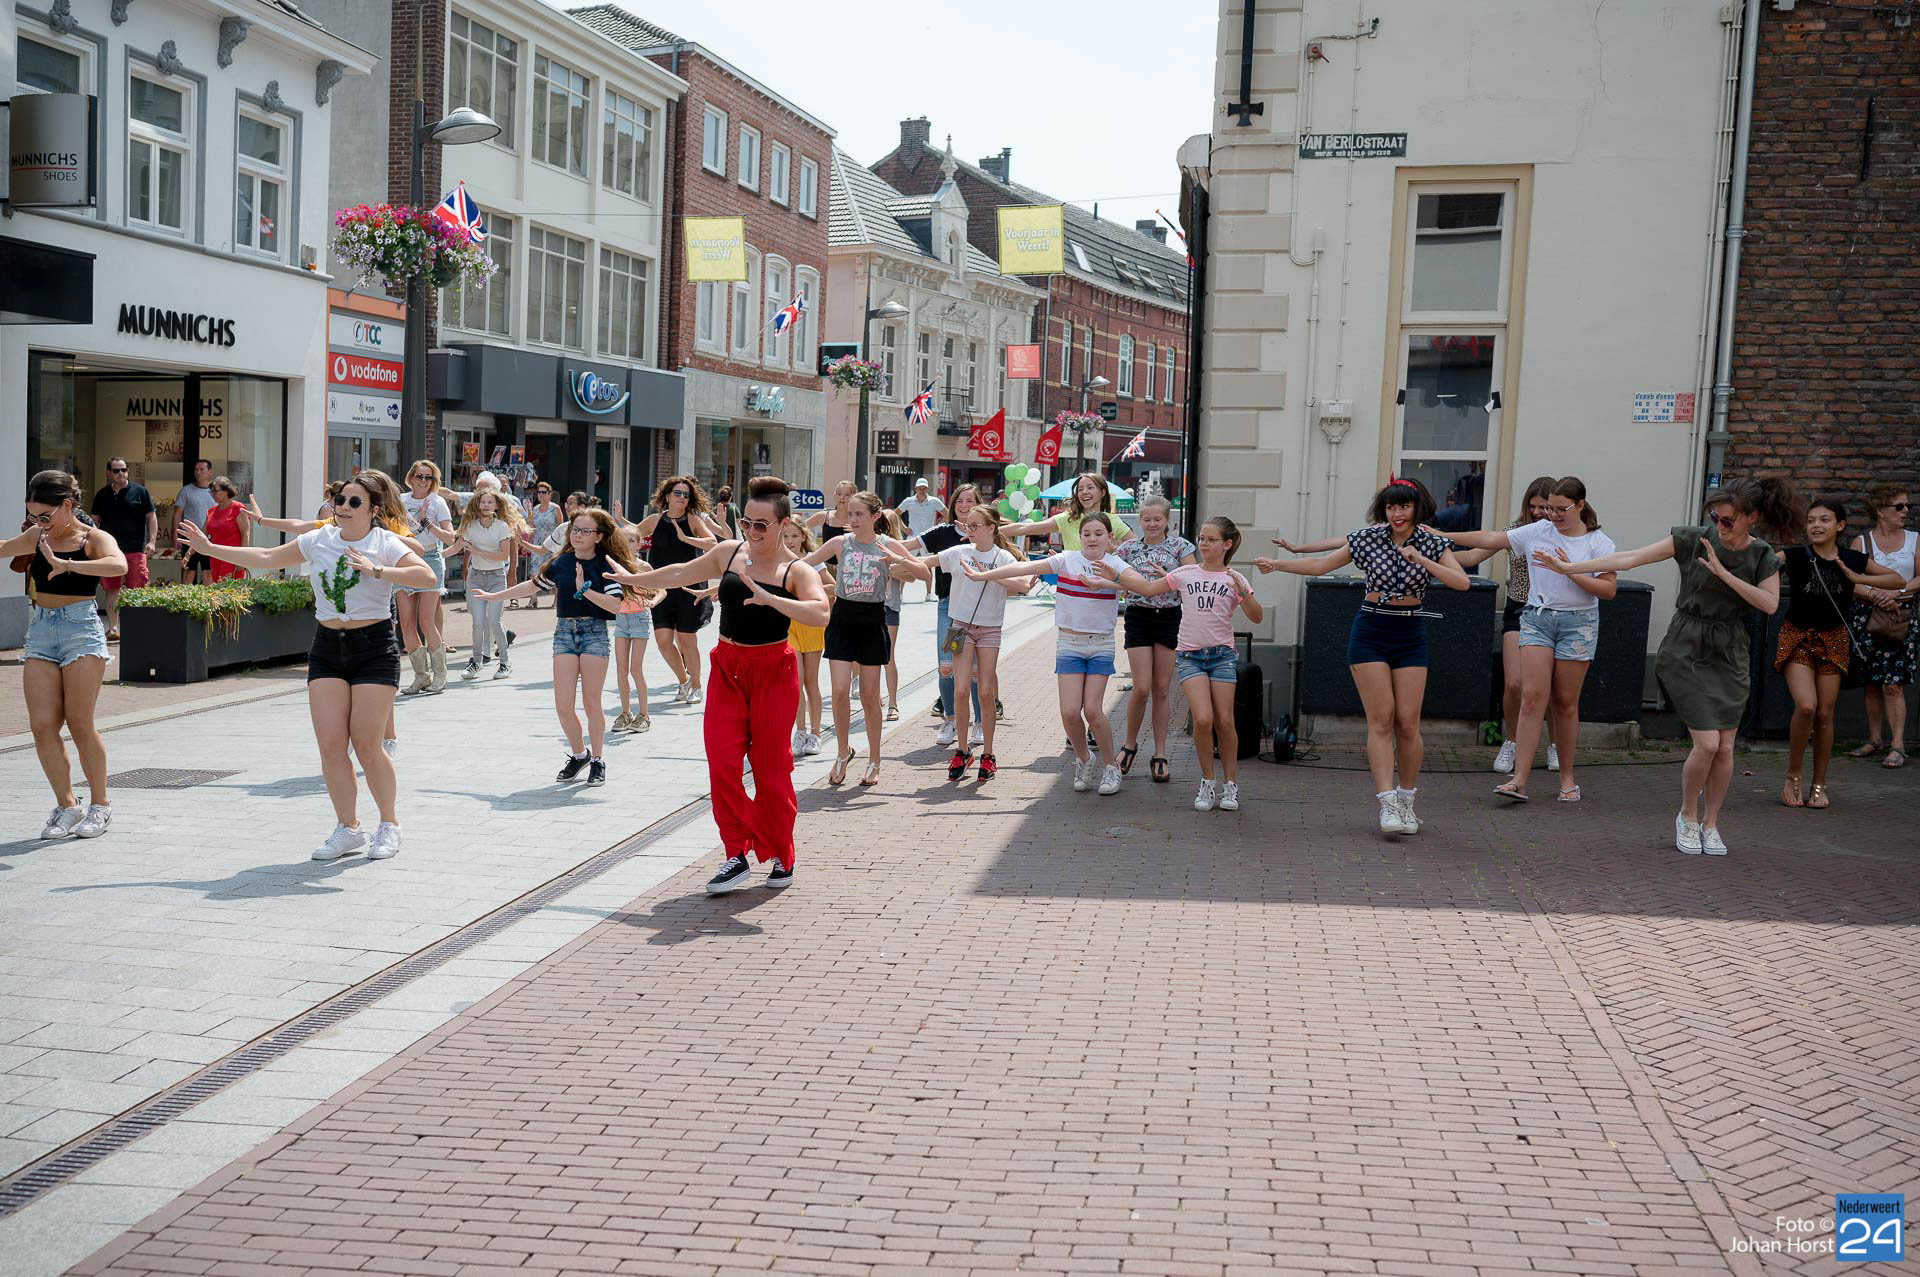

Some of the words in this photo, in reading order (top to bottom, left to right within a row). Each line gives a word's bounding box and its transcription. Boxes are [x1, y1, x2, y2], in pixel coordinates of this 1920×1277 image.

[1301, 136, 1322, 150] VAN
[1325, 136, 1405, 149] BERLOSTRAAT
[11, 152, 78, 166] MUNNICHS
[43, 171, 78, 182] SHOES
[118, 302, 236, 347] MUNNICHS
[364, 323, 381, 345] TCC
[351, 362, 398, 383] vodafone
[881, 465, 916, 475] RITUALS...
[791, 493, 823, 505] etos
[1187, 581, 1229, 598] DREAM
[1197, 596, 1215, 609] ON
